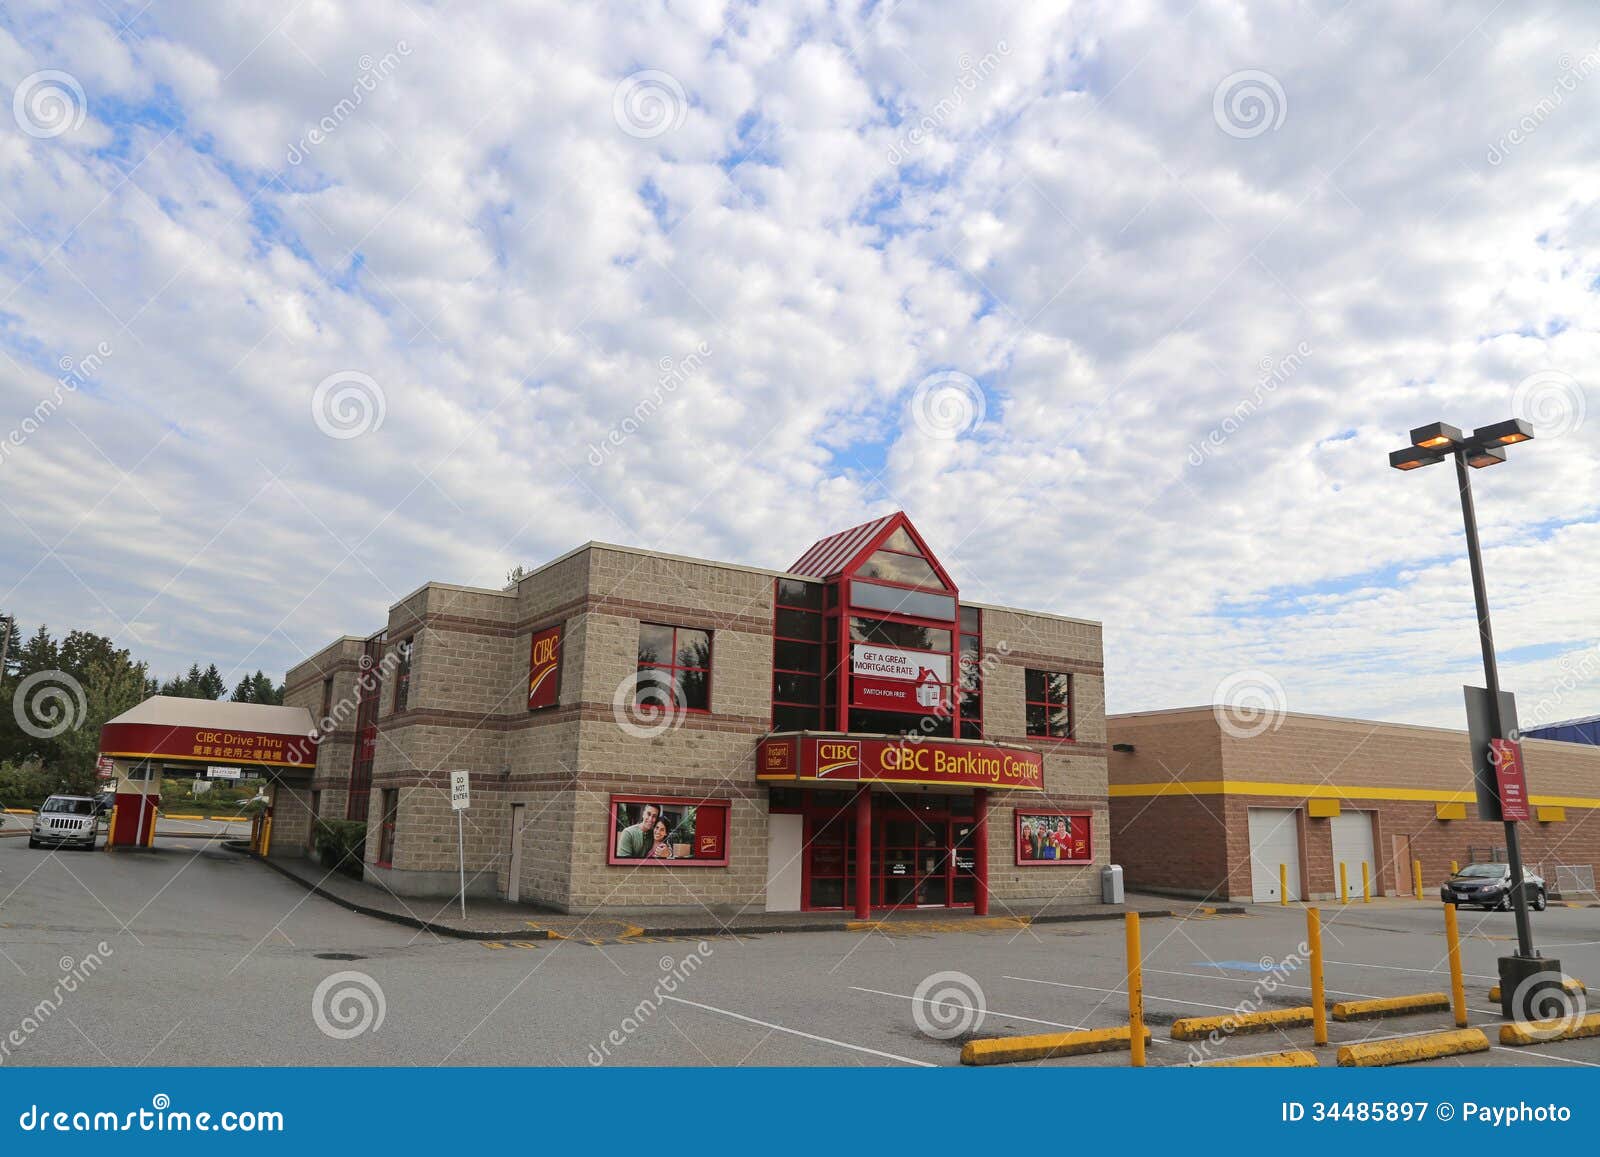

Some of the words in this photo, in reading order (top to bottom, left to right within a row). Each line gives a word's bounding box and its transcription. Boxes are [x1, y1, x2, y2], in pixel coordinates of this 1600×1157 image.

[533, 635, 558, 665] CIBC
[863, 652, 877, 661] GET
[879, 654, 884, 662] A
[885, 655, 907, 665] GREAT
[855, 661, 895, 673] MORTGAGE
[896, 666, 915, 676] RATE.
[863, 687, 882, 696] SWITCH
[883, 689, 893, 697] FOR
[195, 731, 222, 744] CIBC
[223, 733, 254, 746] Drive
[256, 736, 282, 748] Thru
[820, 744, 858, 760] CIBC
[880, 748, 929, 772] CIBC
[934, 750, 1000, 782] Banking
[1003, 756, 1039, 780] Centre
[456, 776, 464, 784] DO
[455, 784, 465, 792] NOT
[453, 792, 468, 801] ENTER
